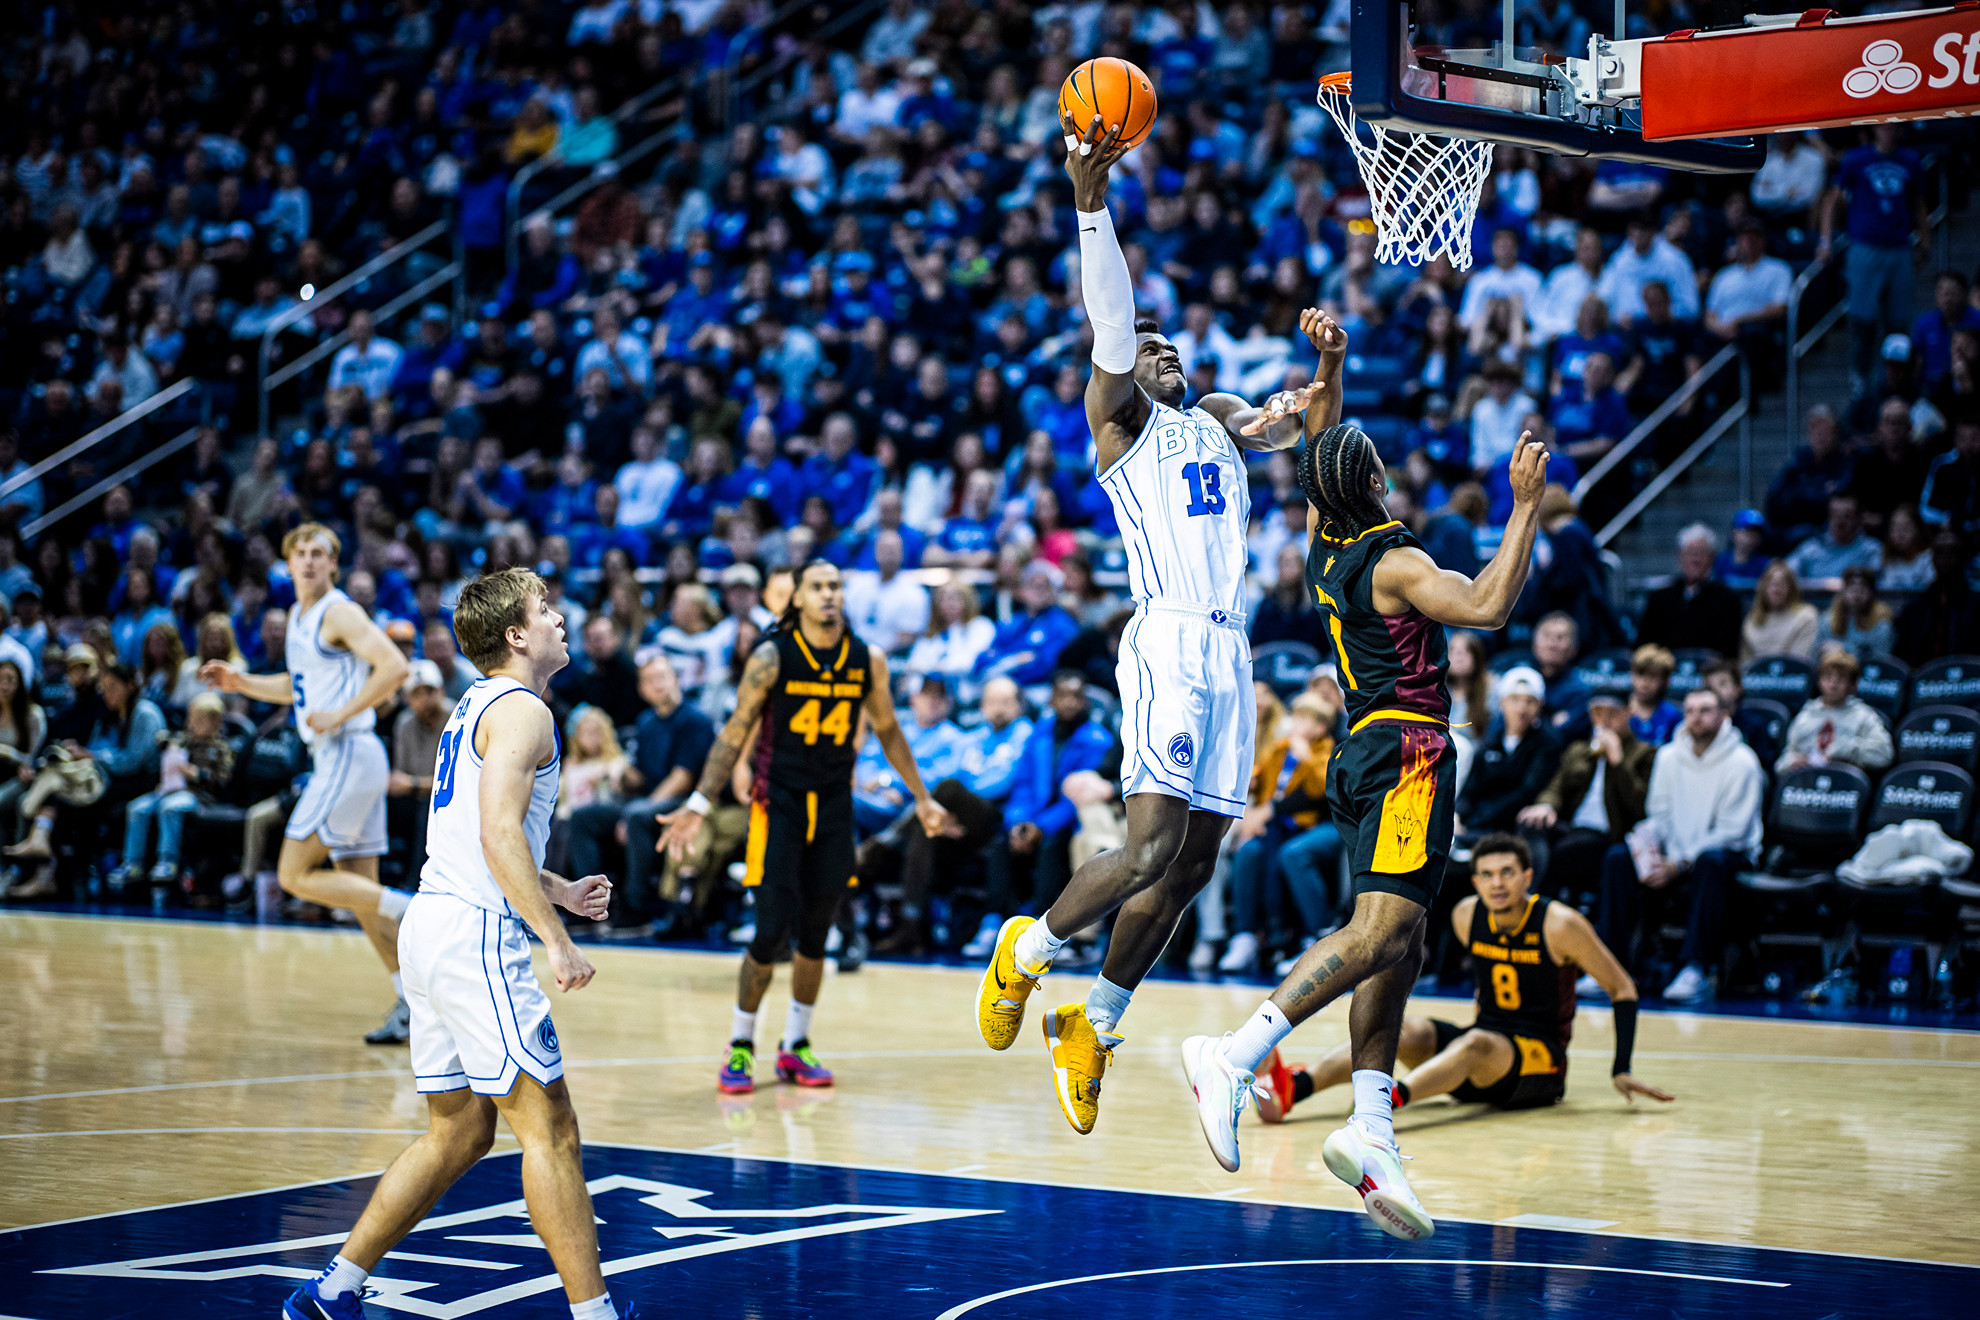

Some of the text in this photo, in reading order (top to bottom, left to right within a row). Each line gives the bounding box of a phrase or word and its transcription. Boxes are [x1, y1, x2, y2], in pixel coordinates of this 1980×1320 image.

[1928, 32, 1980, 89] St
[1157, 420, 1231, 462] BYU
[1181, 462, 1226, 517] 13
[1329, 613, 1358, 690] 1
[789, 698, 852, 746] 44
[1491, 963, 1521, 1011] 8
[1373, 1199, 1420, 1238] HARIBO
